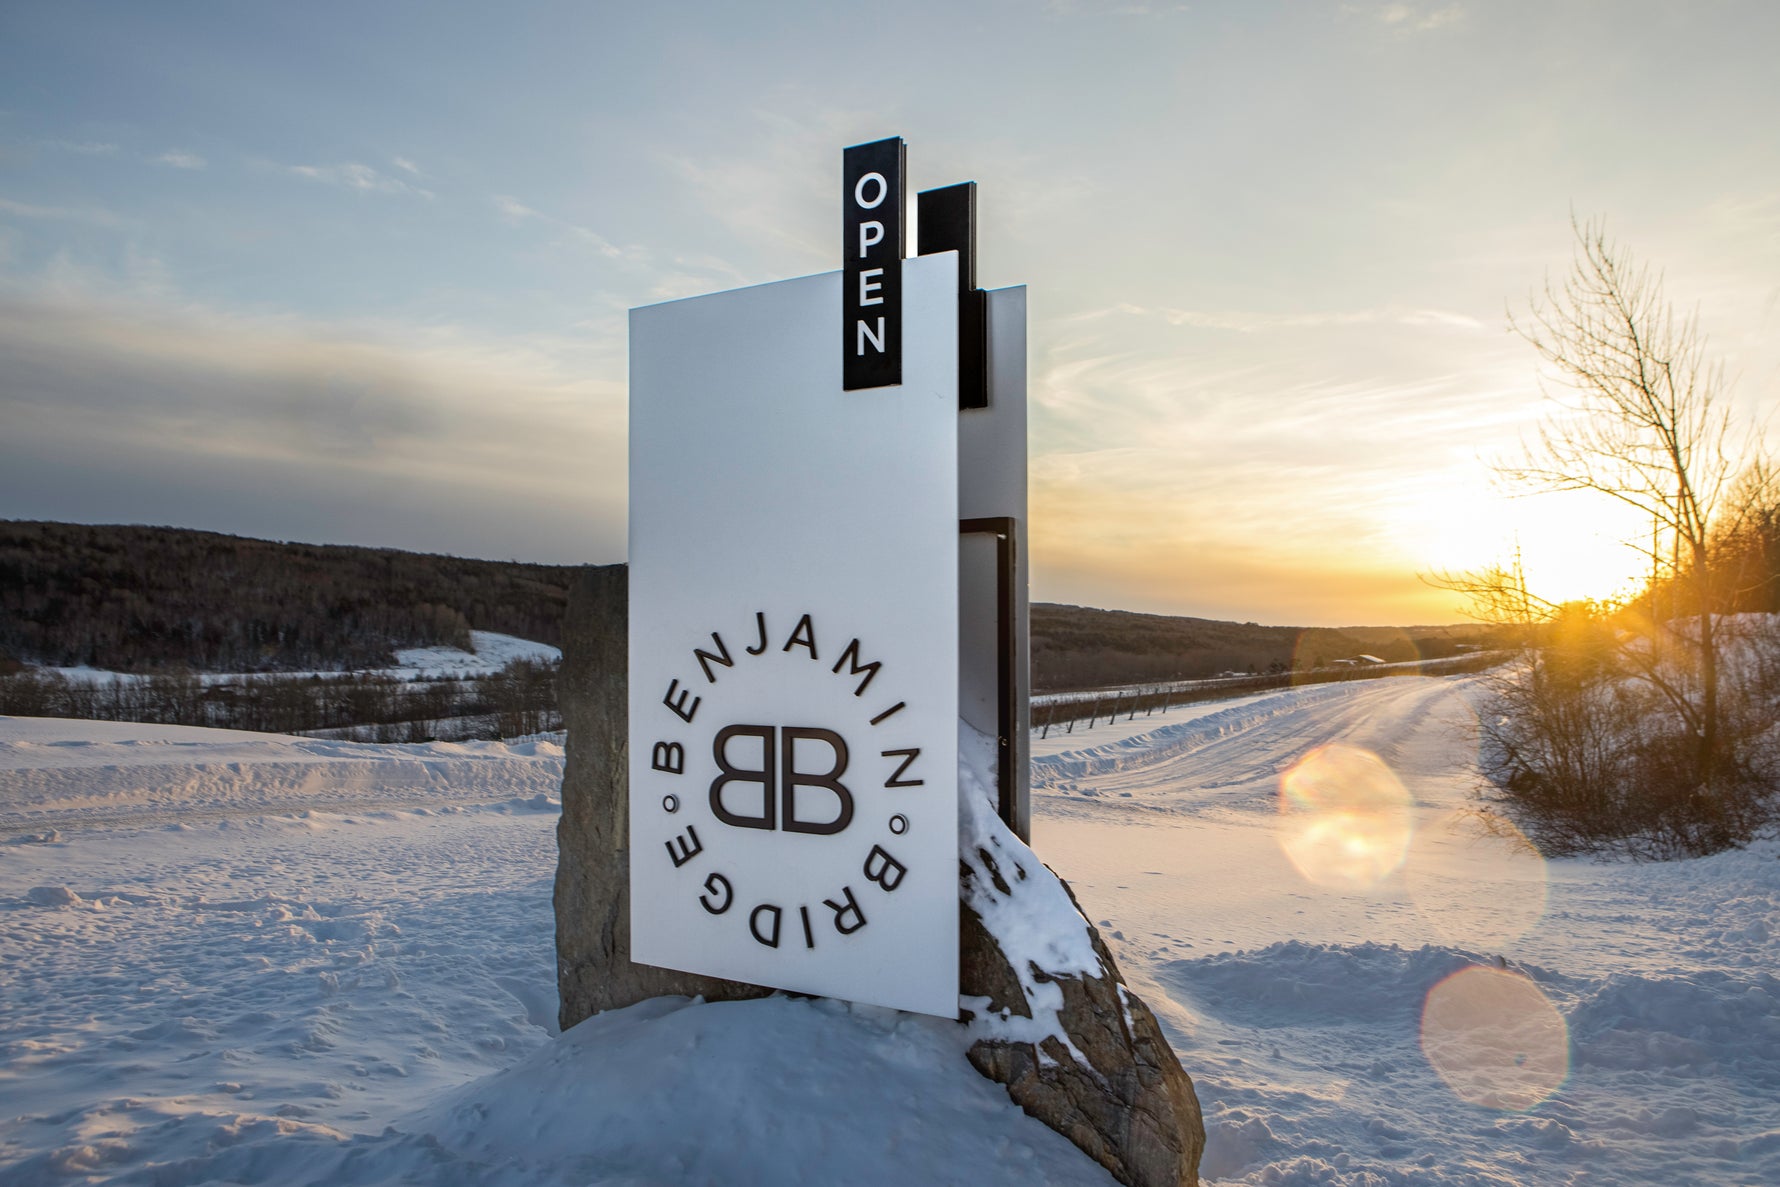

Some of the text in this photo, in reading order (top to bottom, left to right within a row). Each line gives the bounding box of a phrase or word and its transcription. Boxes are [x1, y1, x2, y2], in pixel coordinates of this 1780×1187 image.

[854, 171, 888, 356] OPEN
[651, 611, 924, 951] BENJAMIN BRIDGE
